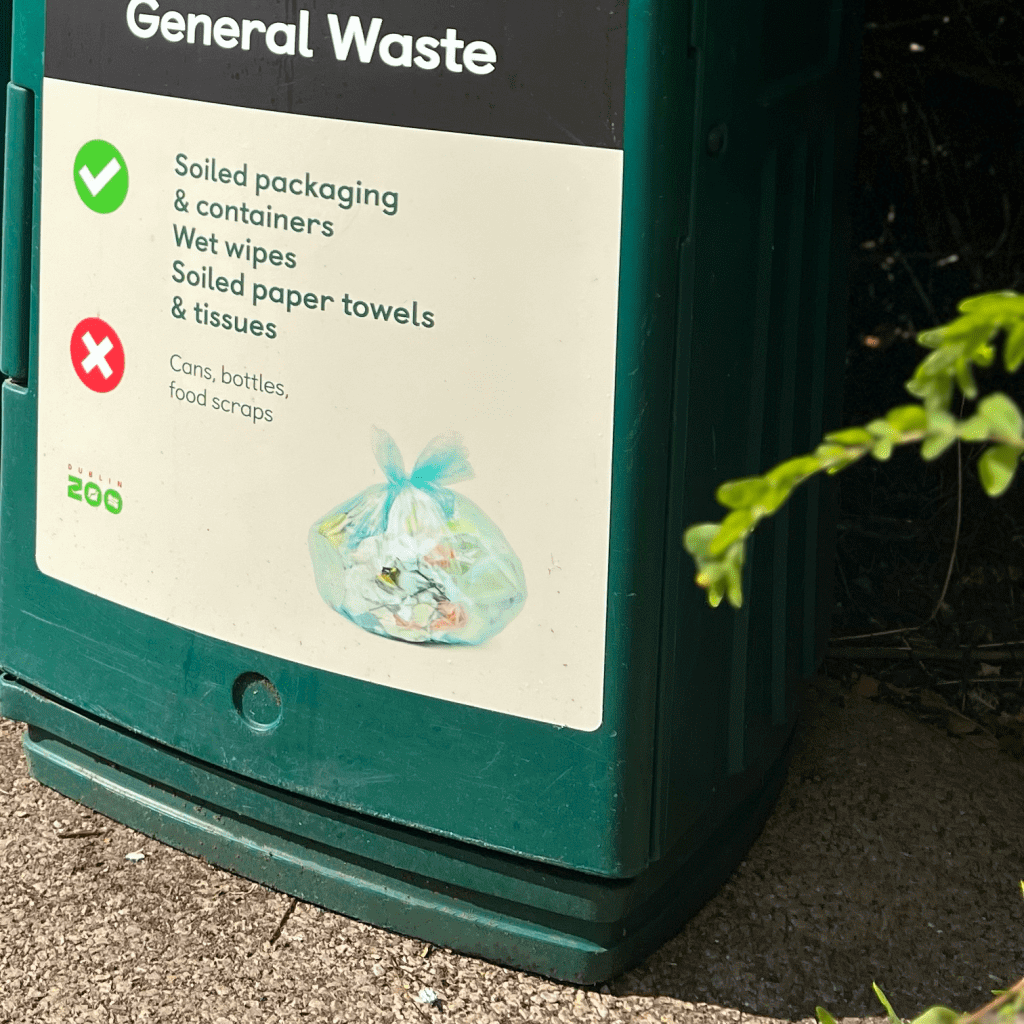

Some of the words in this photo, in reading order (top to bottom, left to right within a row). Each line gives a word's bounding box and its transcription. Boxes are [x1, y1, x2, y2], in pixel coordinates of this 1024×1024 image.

[327, 13, 497, 75] Waste
[174, 152, 247, 187] Soiled
[255, 172, 399, 216] packaging
[173, 188, 189, 213] &
[196, 202, 334, 237] containers
[172, 223, 219, 255] Wet
[225, 238, 297, 269] wipes
[171, 259, 245, 296] Soiled
[252, 282, 334, 312] paper
[341, 293, 435, 328] towels
[171, 295, 187, 320] &
[194, 302, 277, 339] tissues
[169, 354, 216, 383] Cans,
[221, 365, 289, 399] bottles,
[169, 380, 207, 406] food
[211, 396, 273, 424] scraps
[67, 463, 123, 488] DUBLIN
[67, 474, 123, 515] ZOO
